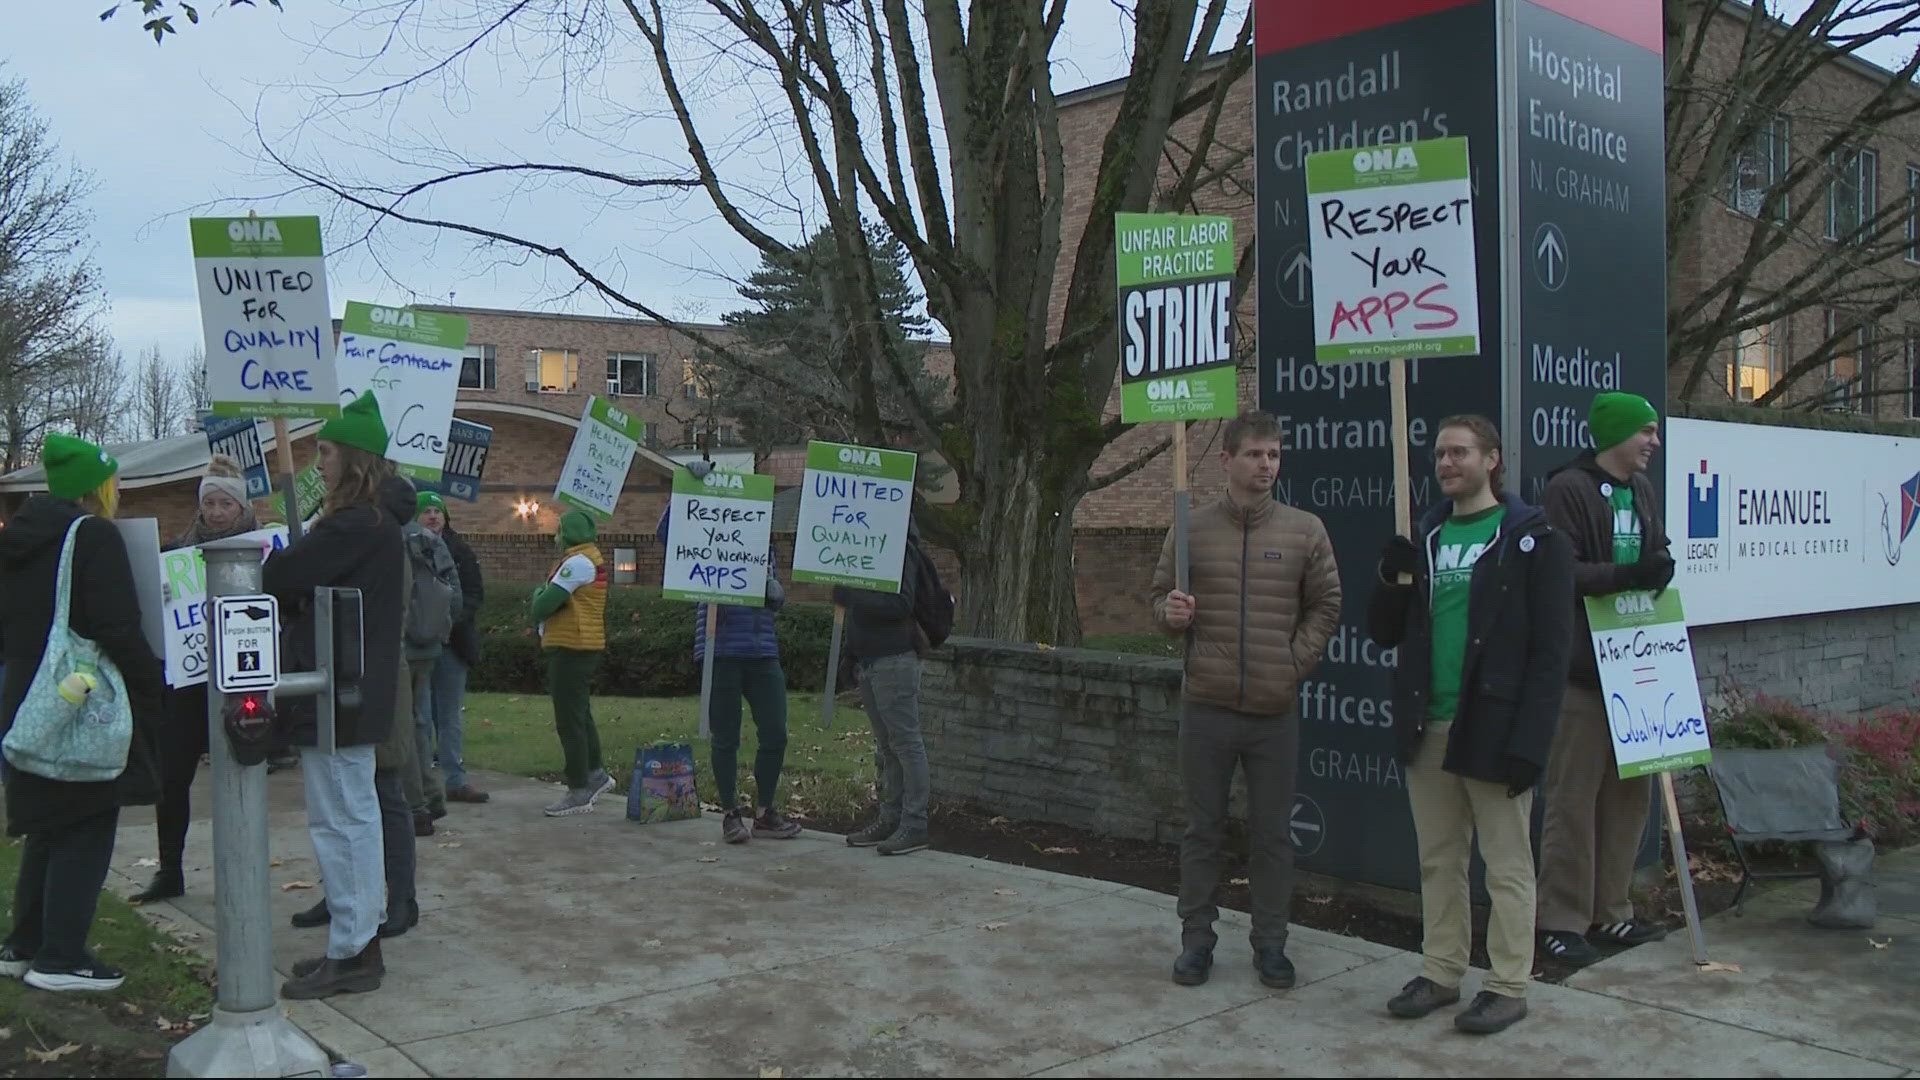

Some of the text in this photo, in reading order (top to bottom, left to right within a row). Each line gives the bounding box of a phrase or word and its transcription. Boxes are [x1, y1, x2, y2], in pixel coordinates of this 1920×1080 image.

[1273, 51, 1400, 116] Randall
[1528, 36, 1623, 103] Hospital
[1529, 98, 1628, 164] Entrance
[1353, 147, 1418, 172] ONA
[1530, 160, 1630, 214] N. GRAHAM
[1274, 200, 1297, 227] N.
[1321, 199, 1469, 239] RESPECT
[228, 220, 282, 242] ONA
[1122, 221, 1228, 253] UNFAIR LABOR
[1143, 250, 1215, 278] PRACTICE
[213, 266, 313, 296] UNITED
[370, 308, 416, 328] ONA
[1329, 283, 1458, 340] APPS
[224, 326, 320, 360] QUALITY
[1125, 281, 1231, 377] STRIKE
[241, 359, 312, 391] CARE
[371, 365, 401, 390] for
[1276, 357, 1419, 399] Hospitl
[1532, 343, 1621, 391] Medical
[1147, 380, 1191, 400] ONA
[396, 404, 446, 454] Care
[607, 407, 629, 428] ONA
[1532, 405, 1597, 449] Offic
[1277, 416, 1428, 450] Entrane
[445, 442, 487, 478] RIKE
[838, 448, 882, 467] ONA
[703, 473, 744, 489] ONA
[815, 473, 904, 502] UNITED
[687, 499, 766, 524] RESPECT
[1739, 489, 1831, 525] EMANUEL
[812, 525, 887, 554] QUALITY
[1687, 543, 1719, 560] LEGACY
[1739, 539, 1849, 557] MEDICAL CENTER
[819, 546, 875, 570] CARE
[1437, 543, 1485, 571] NA
[1687, 564, 1719, 574] HEALTH
[689, 563, 747, 590] APPS
[1615, 594, 1654, 615] ONA
[183, 633, 206, 650] to
[238, 638, 258, 649] FOR
[1327, 624, 1398, 668] dica
[183, 646, 208, 672] OU
[1299, 681, 1394, 728] ffices
[1663, 692, 1704, 739] Care
[1310, 748, 1400, 788] GRAHA
